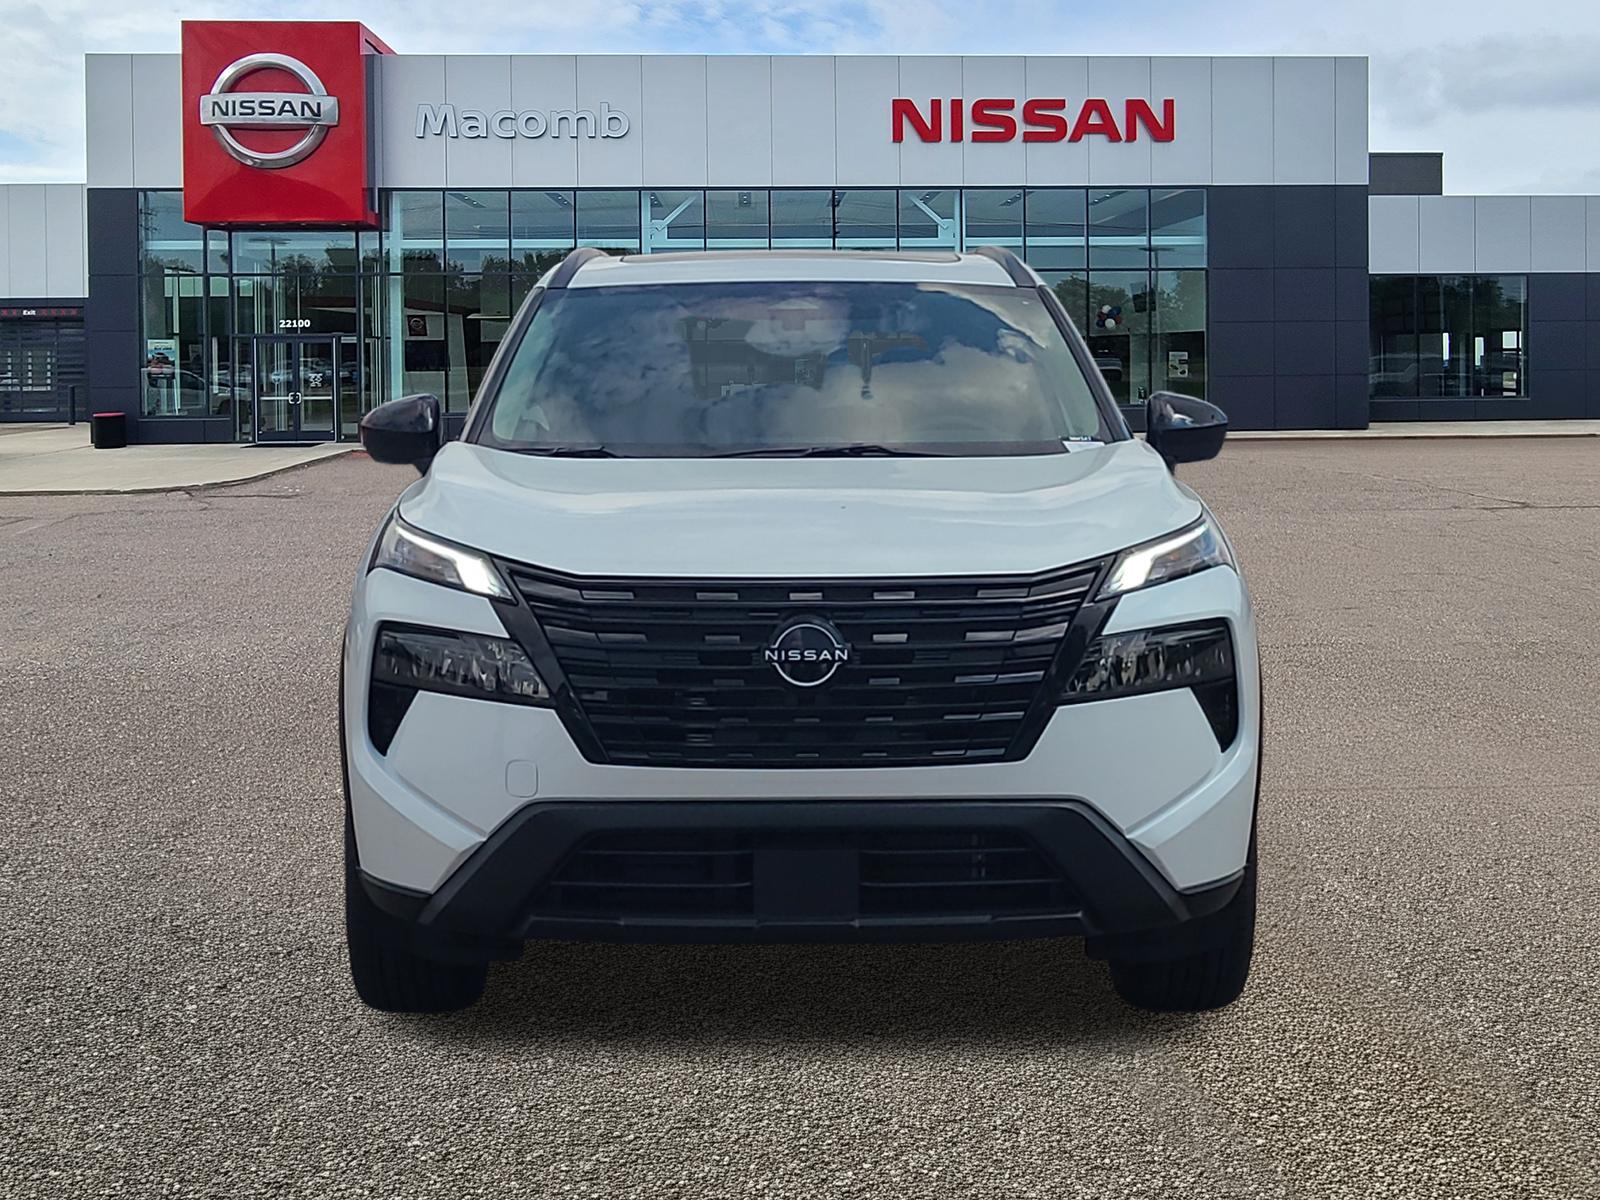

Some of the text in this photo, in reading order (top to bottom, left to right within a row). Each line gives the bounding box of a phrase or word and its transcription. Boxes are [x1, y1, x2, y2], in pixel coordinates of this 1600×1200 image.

[211, 100, 322, 117] NISSAN
[415, 102, 630, 138] Macomb
[892, 98, 1175, 142] NISSAN
[279, 319, 311, 328] 22100
[764, 649, 848, 660] NISSAN
